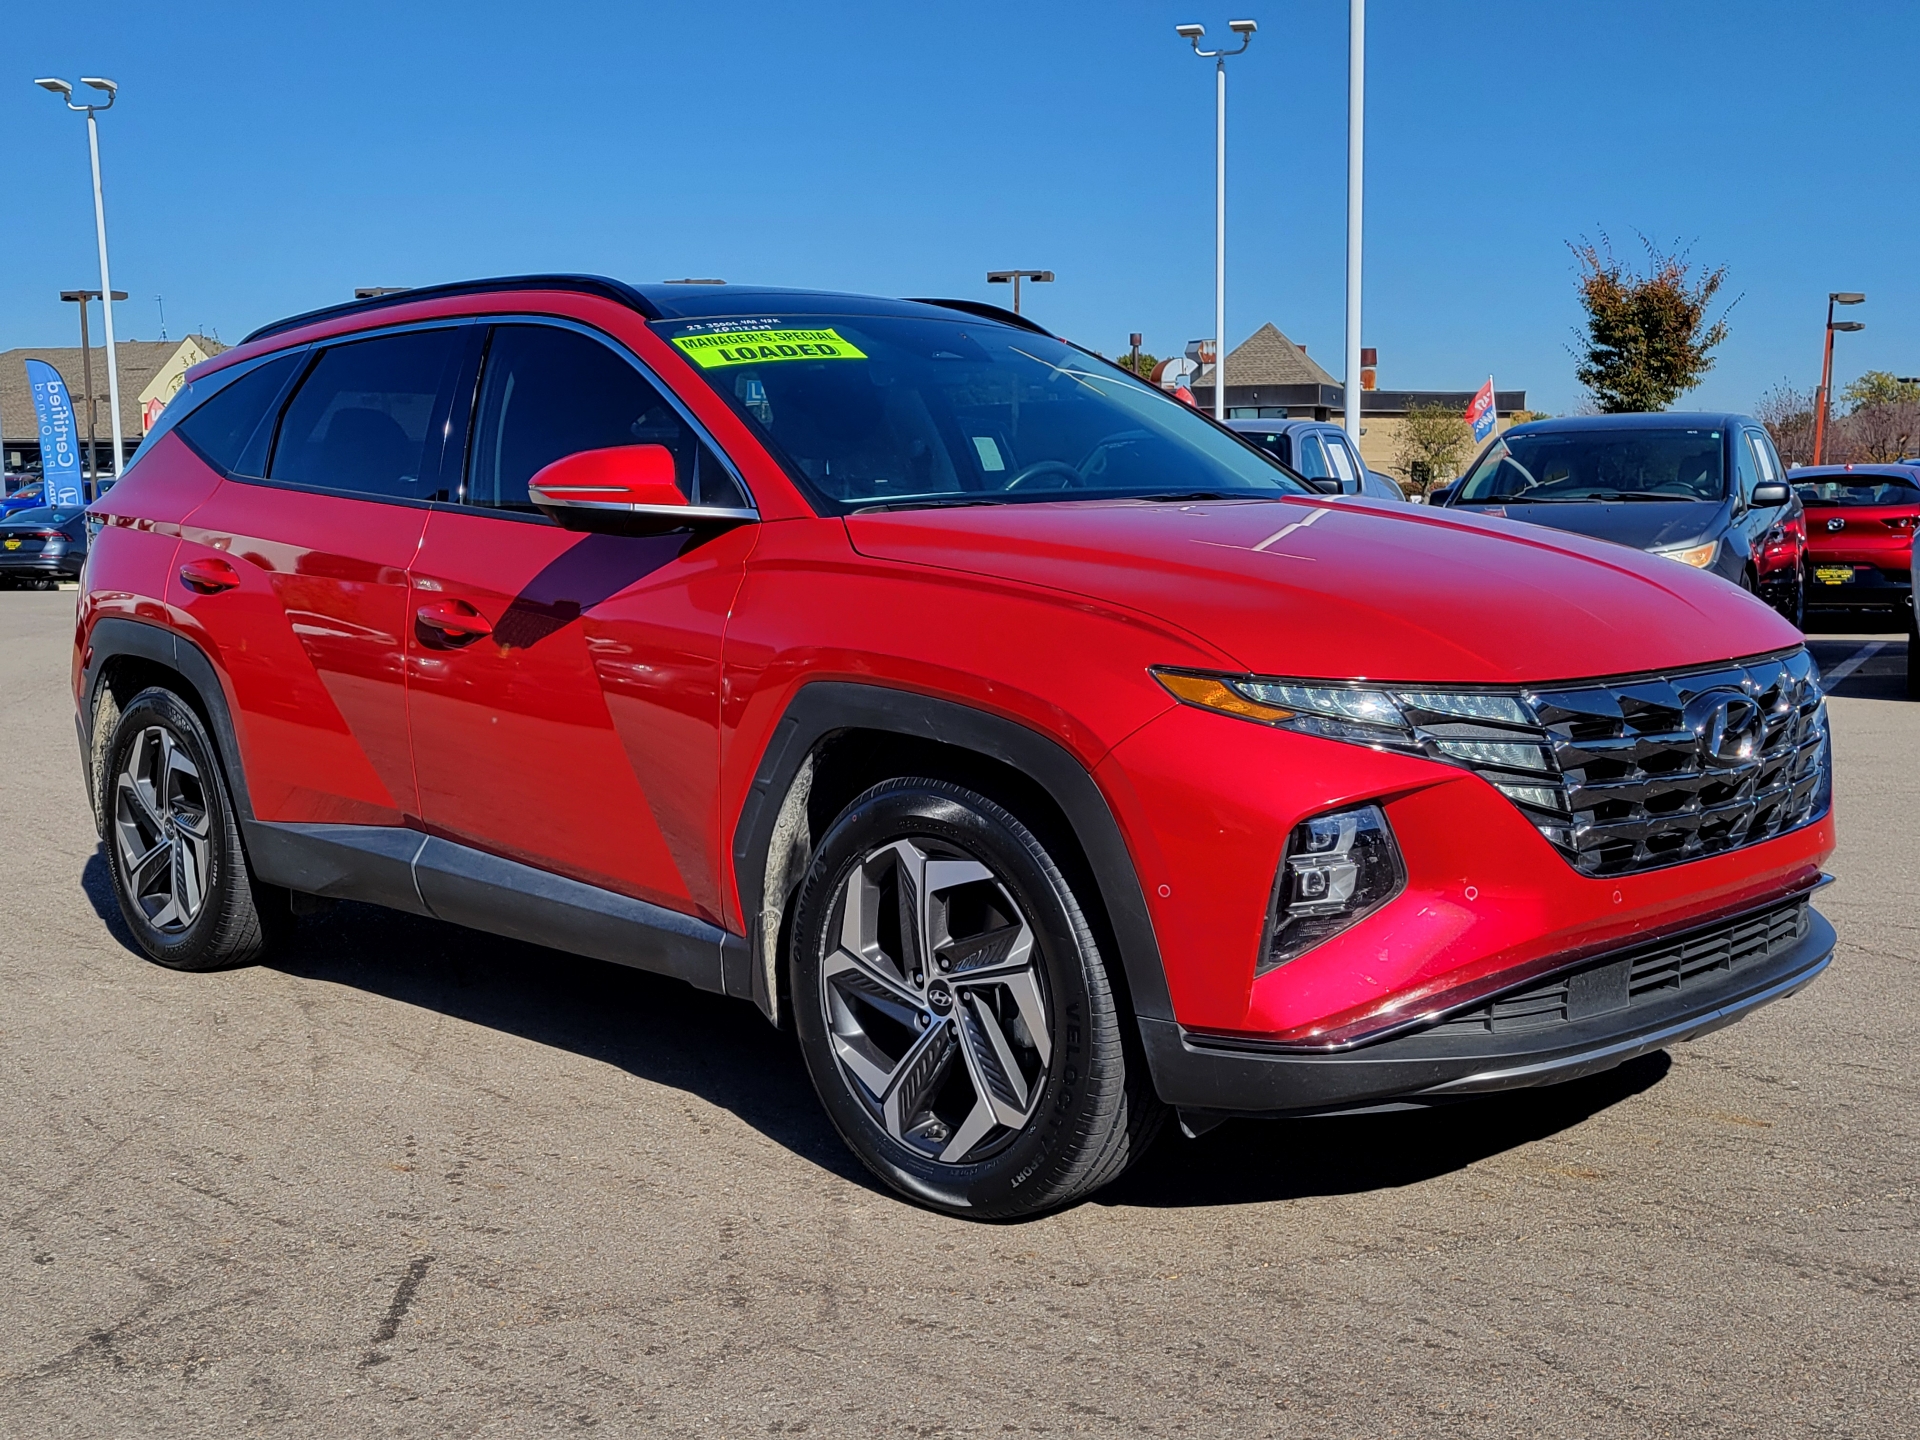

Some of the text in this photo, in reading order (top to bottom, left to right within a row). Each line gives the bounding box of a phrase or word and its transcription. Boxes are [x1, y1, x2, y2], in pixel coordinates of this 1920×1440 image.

[681, 331, 837, 350] MANAGER'S SPECIAL
[718, 343, 839, 362] LOADED
[1010, 1153, 1047, 1189] SPORT
